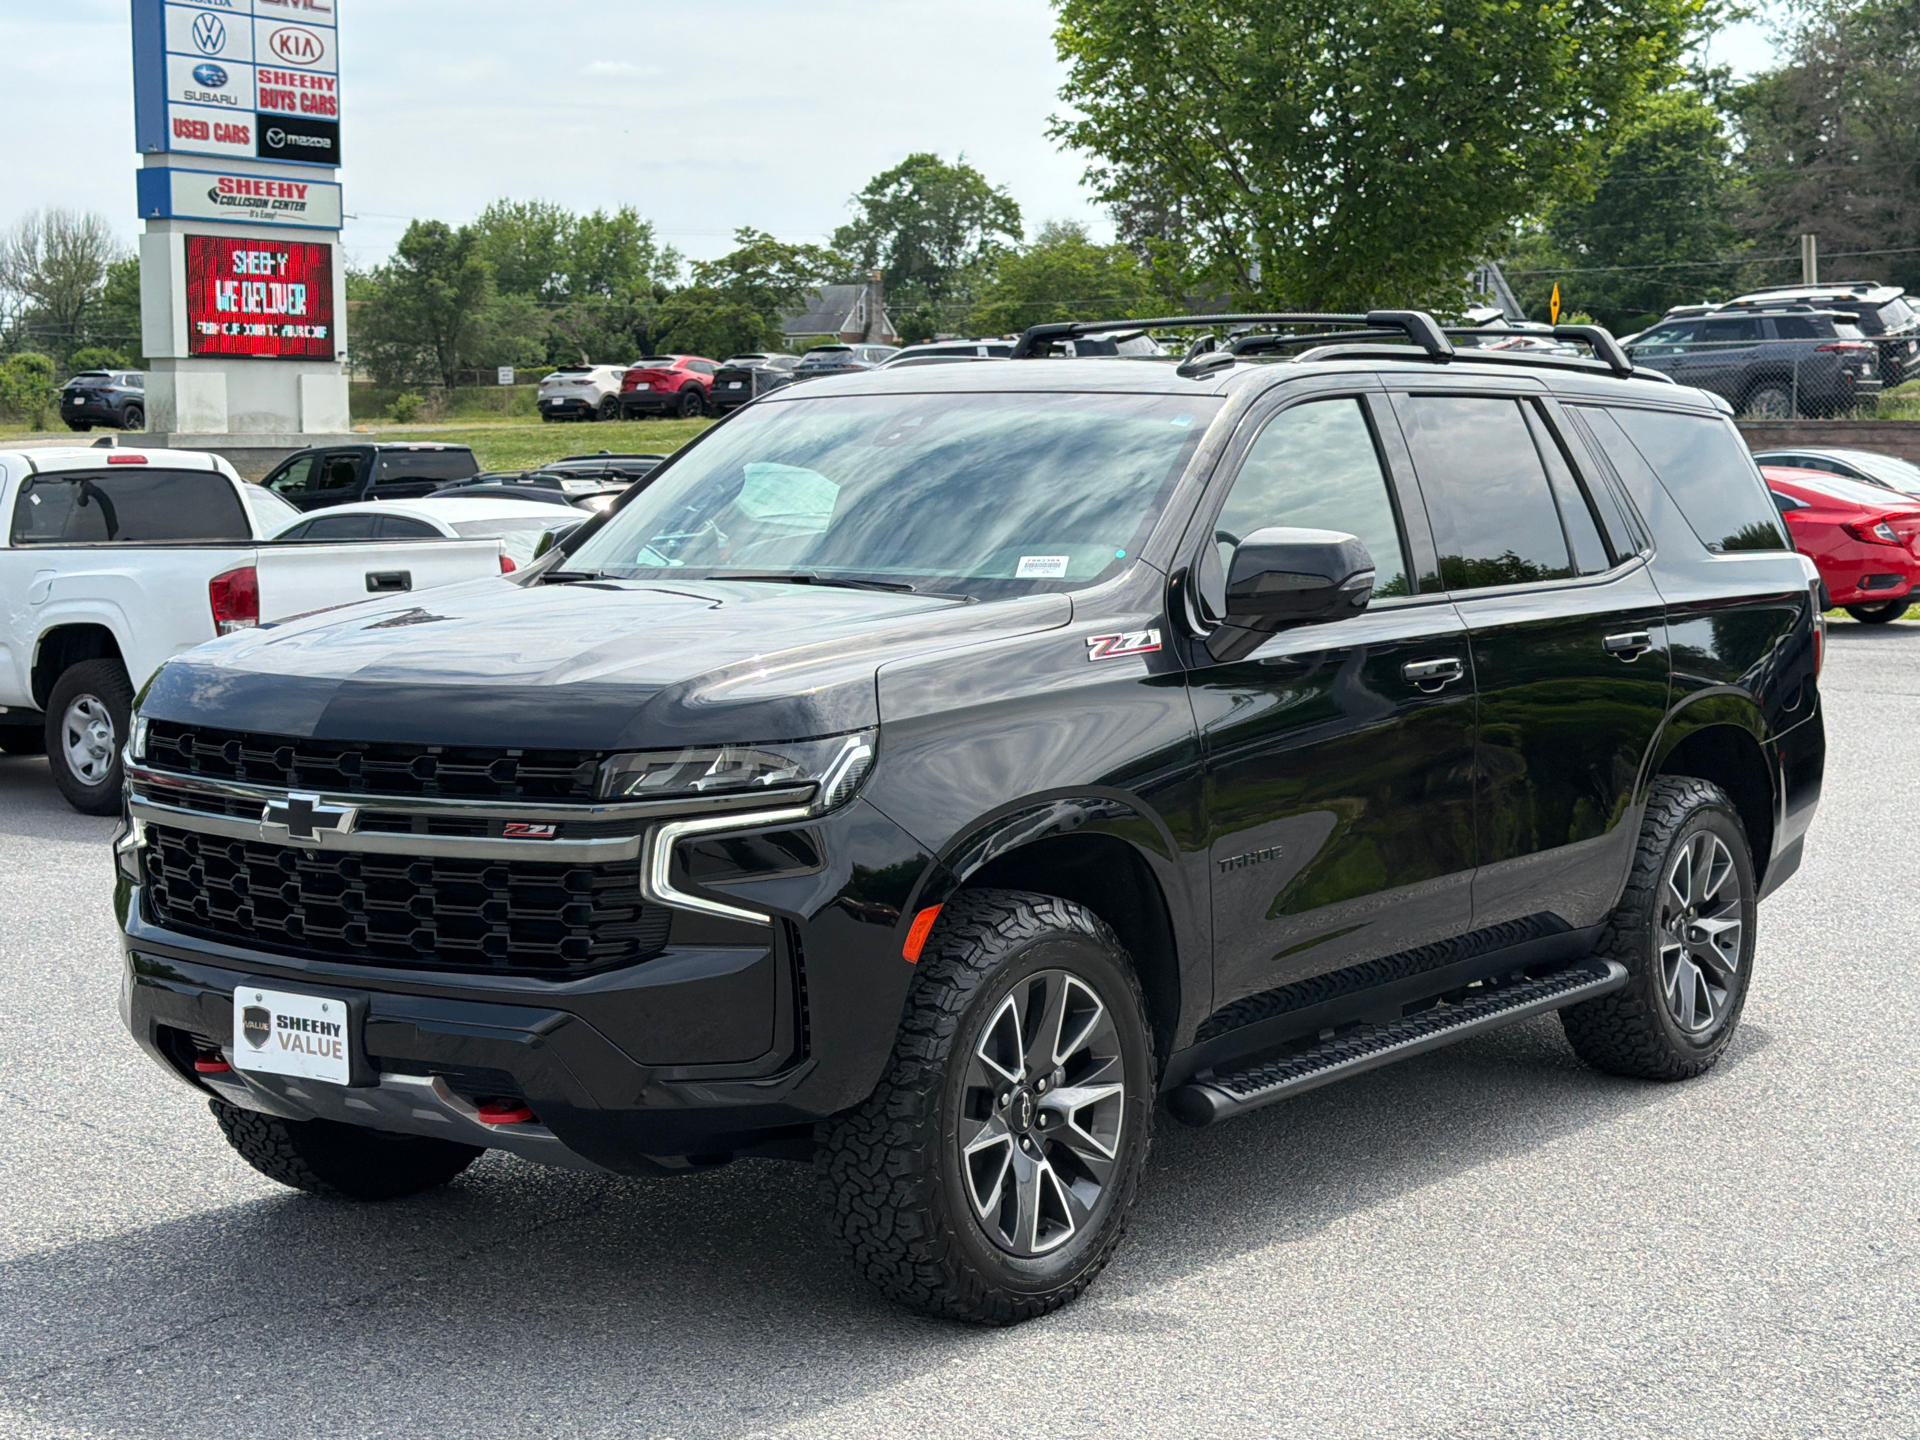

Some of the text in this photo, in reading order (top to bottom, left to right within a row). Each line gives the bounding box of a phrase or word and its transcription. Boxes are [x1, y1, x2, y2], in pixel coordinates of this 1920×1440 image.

[279, 34, 316, 58] KIA
[258, 69, 335, 92] SHEEHY
[184, 90, 238, 105] SUBARU
[260, 87, 337, 116] BUYS CARS
[173, 117, 250, 145] USED CARS
[286, 134, 331, 149] mazda
[218, 177, 308, 200] SHEEHY
[219, 195, 307, 212] COLLISION CENTER
[1086, 628, 1162, 661] Z71
[503, 823, 556, 837] Z71
[1218, 845, 1283, 873] TAHOE
[243, 1020, 270, 1031] VALUE
[276, 1014, 341, 1038] SHEEHY
[277, 1031, 343, 1061] VALUE
